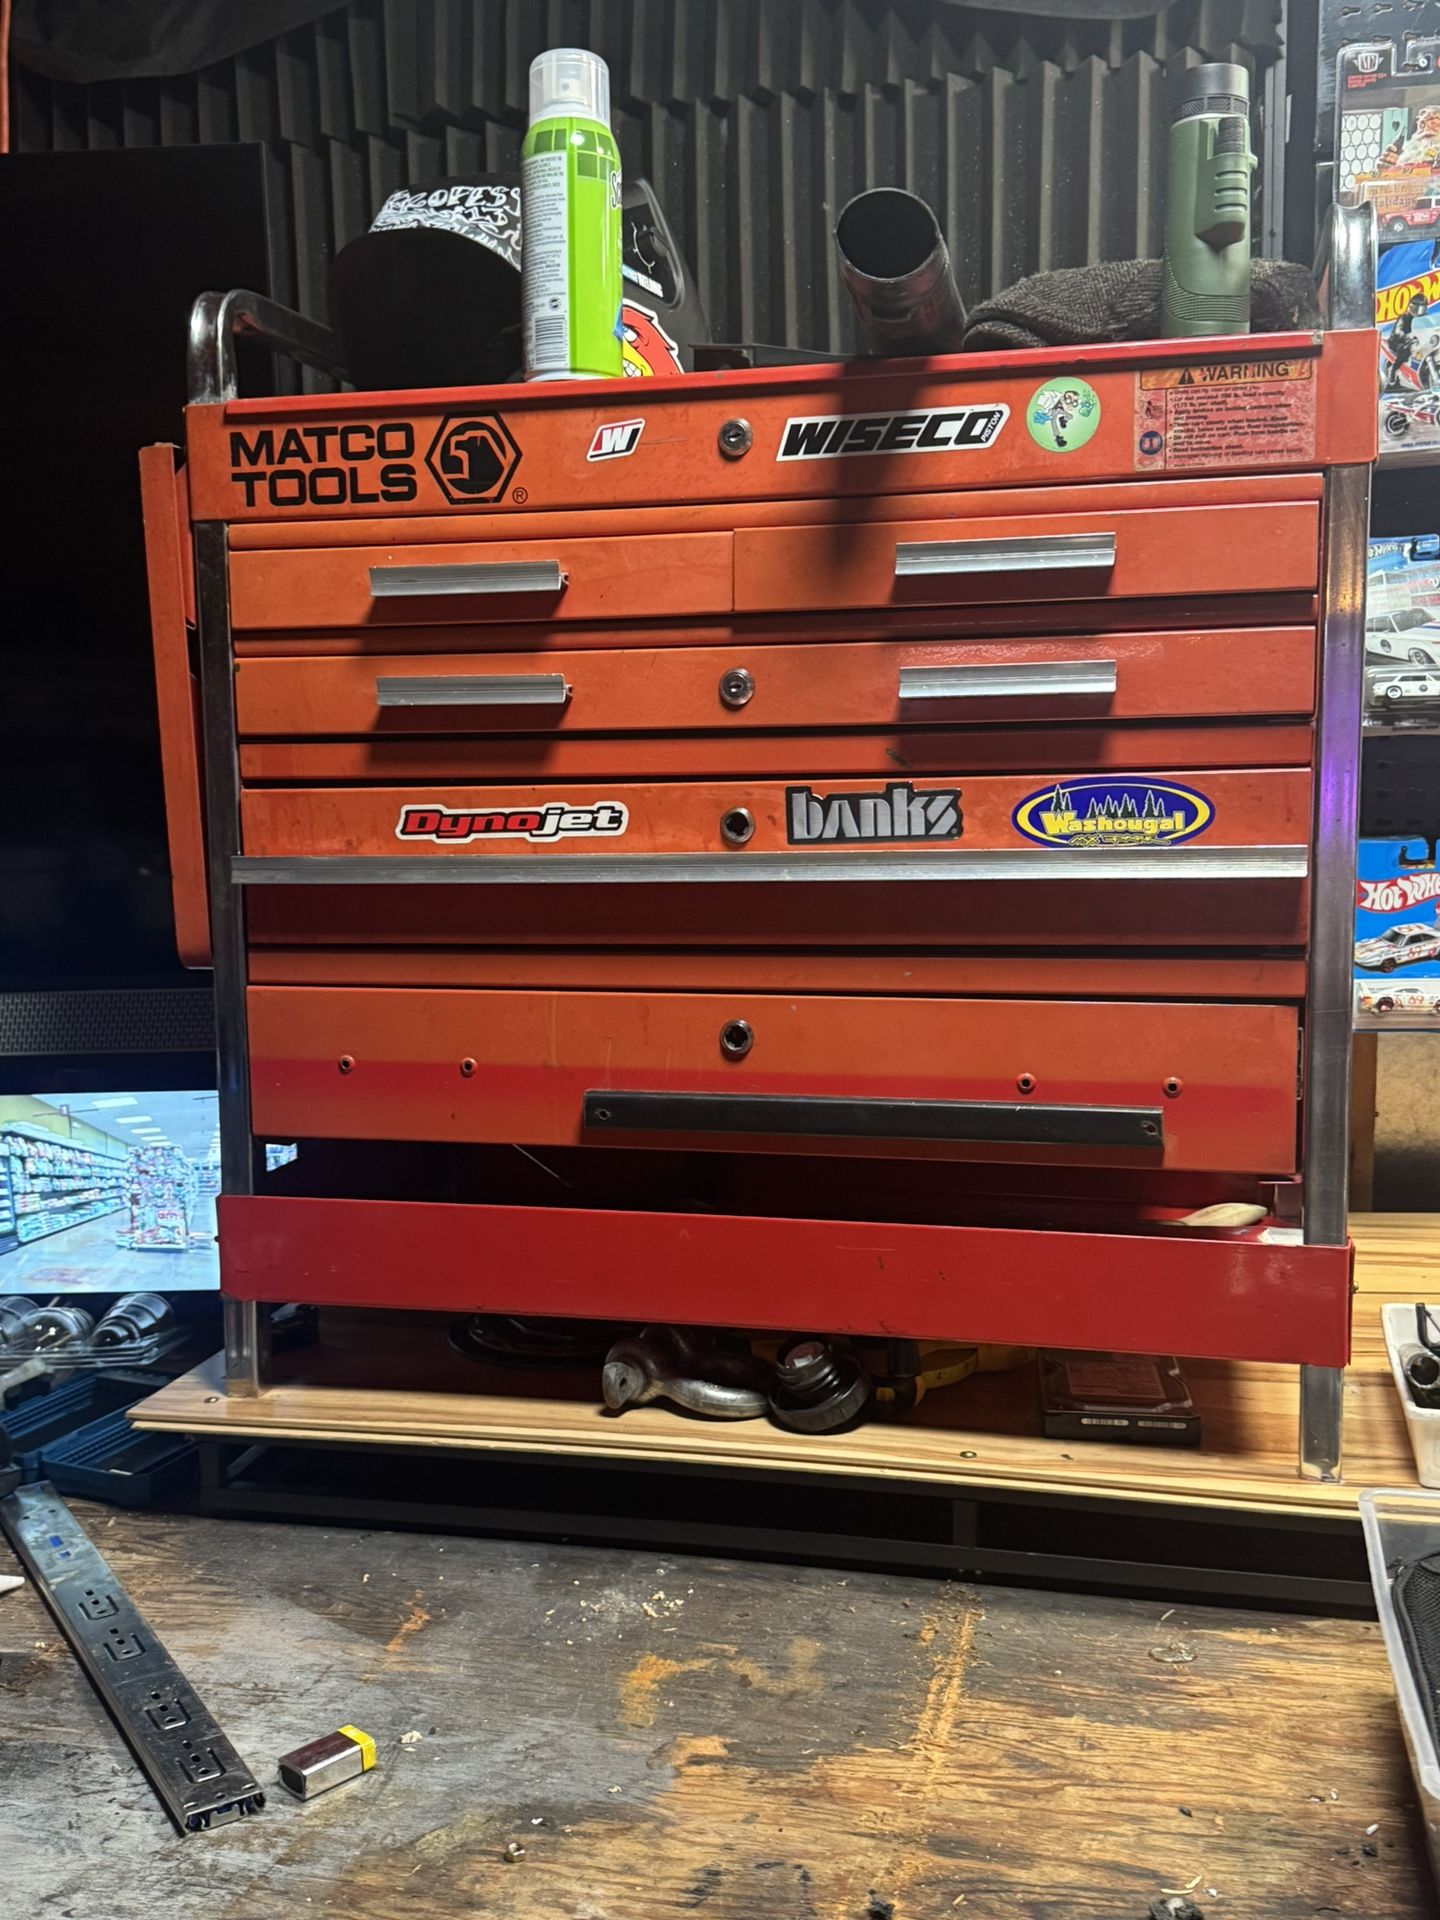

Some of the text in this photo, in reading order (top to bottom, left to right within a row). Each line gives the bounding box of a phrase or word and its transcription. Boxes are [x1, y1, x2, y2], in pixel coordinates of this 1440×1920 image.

[1200, 362, 1290, 382] WARNING
[229, 422, 415, 468] MATCO
[781, 409, 1005, 457] WISECO
[980, 411, 1002, 442] PISTON
[231, 464, 418, 508] TOOLS
[404, 806, 623, 837] Dynojet
[791, 786, 958, 840] banks
[1040, 810, 1185, 836] Washougal
